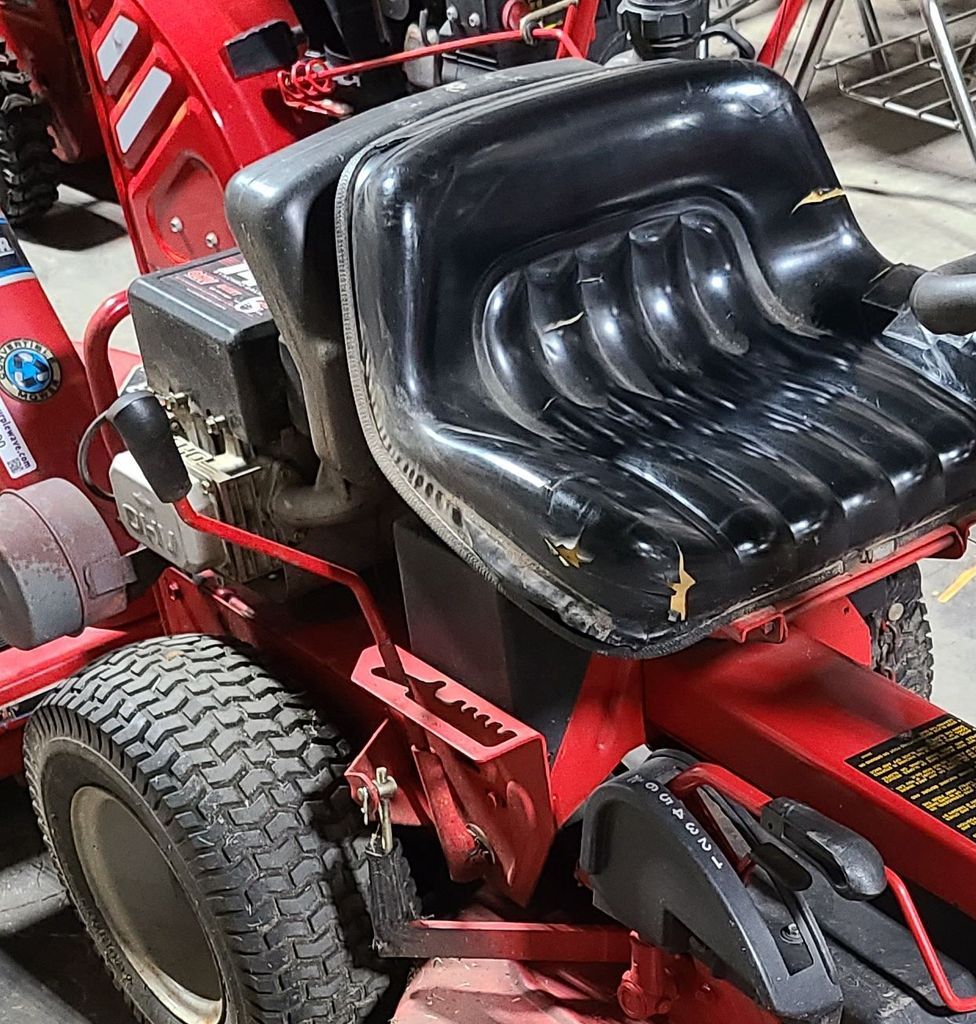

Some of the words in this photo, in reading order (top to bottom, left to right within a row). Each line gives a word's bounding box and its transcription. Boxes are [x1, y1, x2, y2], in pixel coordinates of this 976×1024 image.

[659, 793, 674, 806] 5
[672, 808, 684, 820] 4
[685, 822, 699, 835] 3
[697, 837, 712, 851] 2
[711, 855, 723, 870] 1
